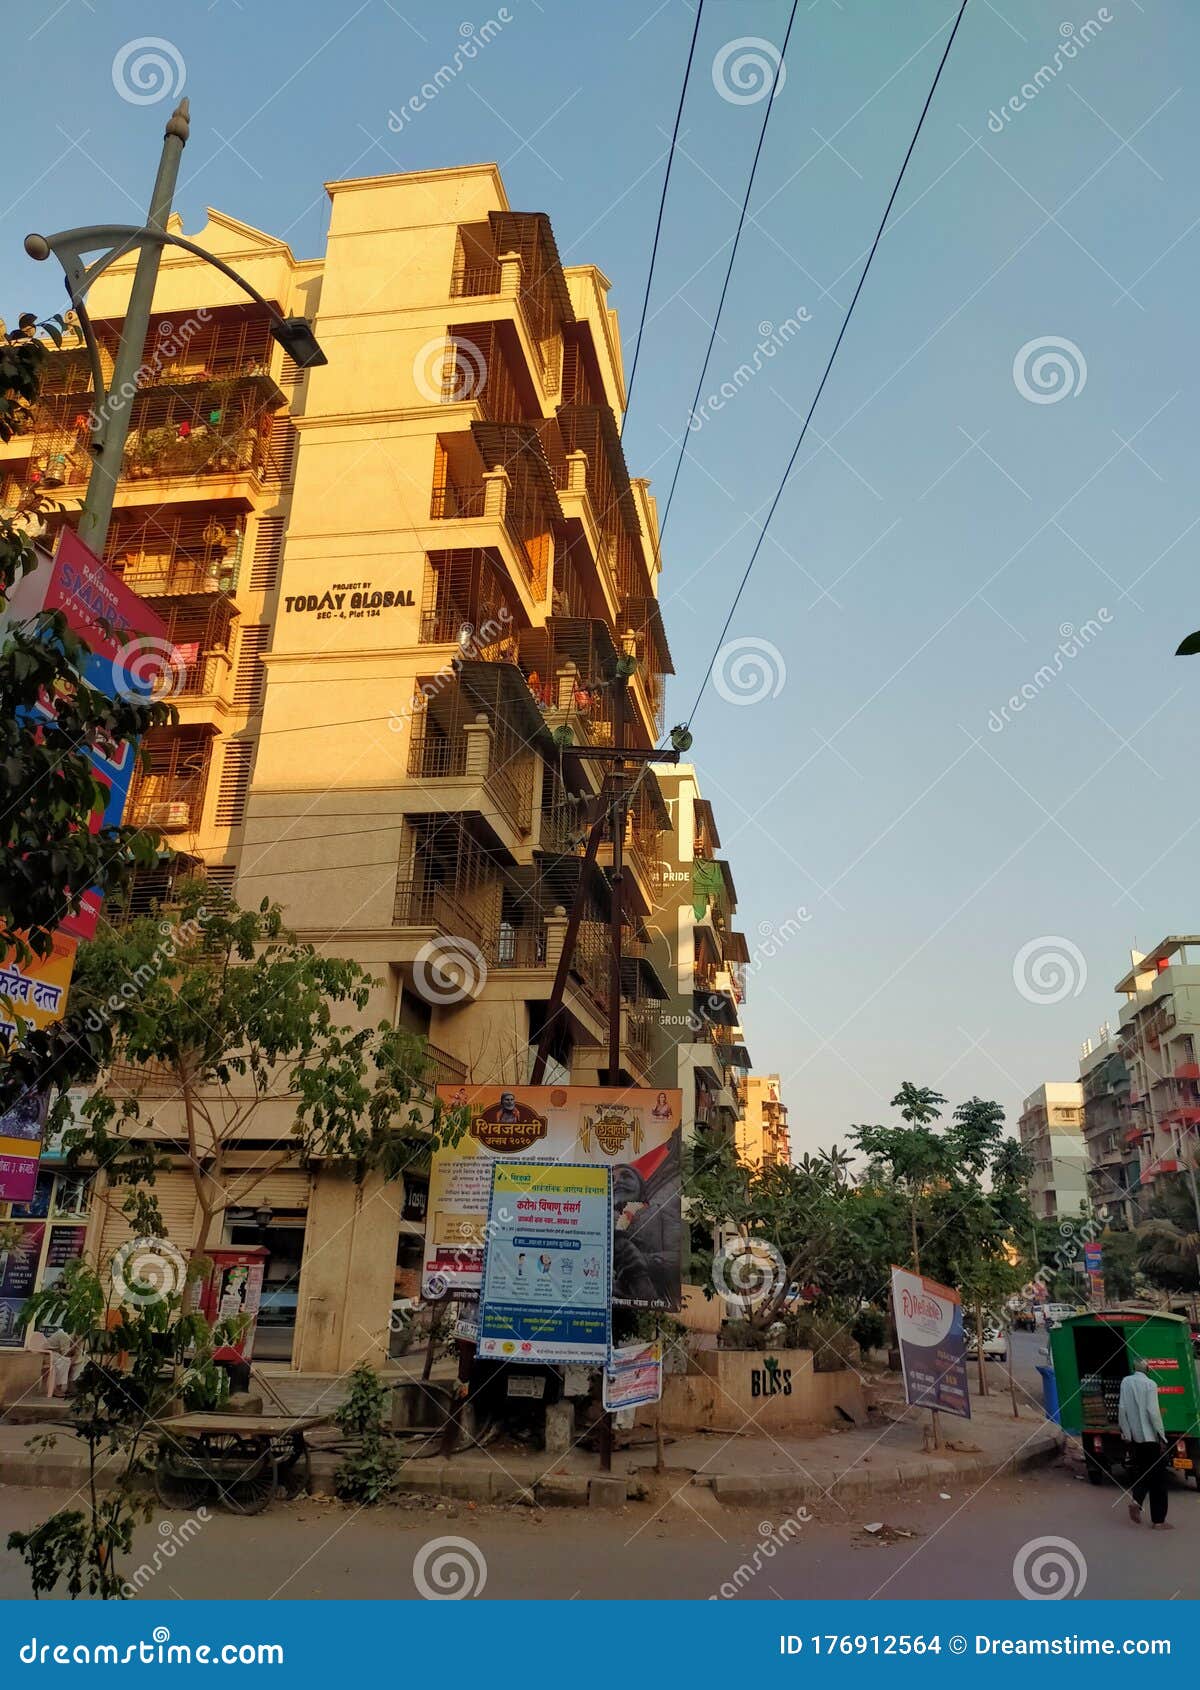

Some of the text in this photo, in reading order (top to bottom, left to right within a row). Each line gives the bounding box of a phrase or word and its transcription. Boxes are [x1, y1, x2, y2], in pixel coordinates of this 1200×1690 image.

[82, 563, 119, 607] Reliance
[60, 563, 131, 631] SMART
[285, 590, 415, 613] TODAY GLOBAL
[316, 611, 332, 620] SEC
[349, 610, 364, 618] Plot
[367, 609, 380, 617] 134
[663, 872, 690, 881] PRIDE
[659, 1016, 691, 1025] GROUP
[475, 1118, 542, 1135] शिवजयंती
